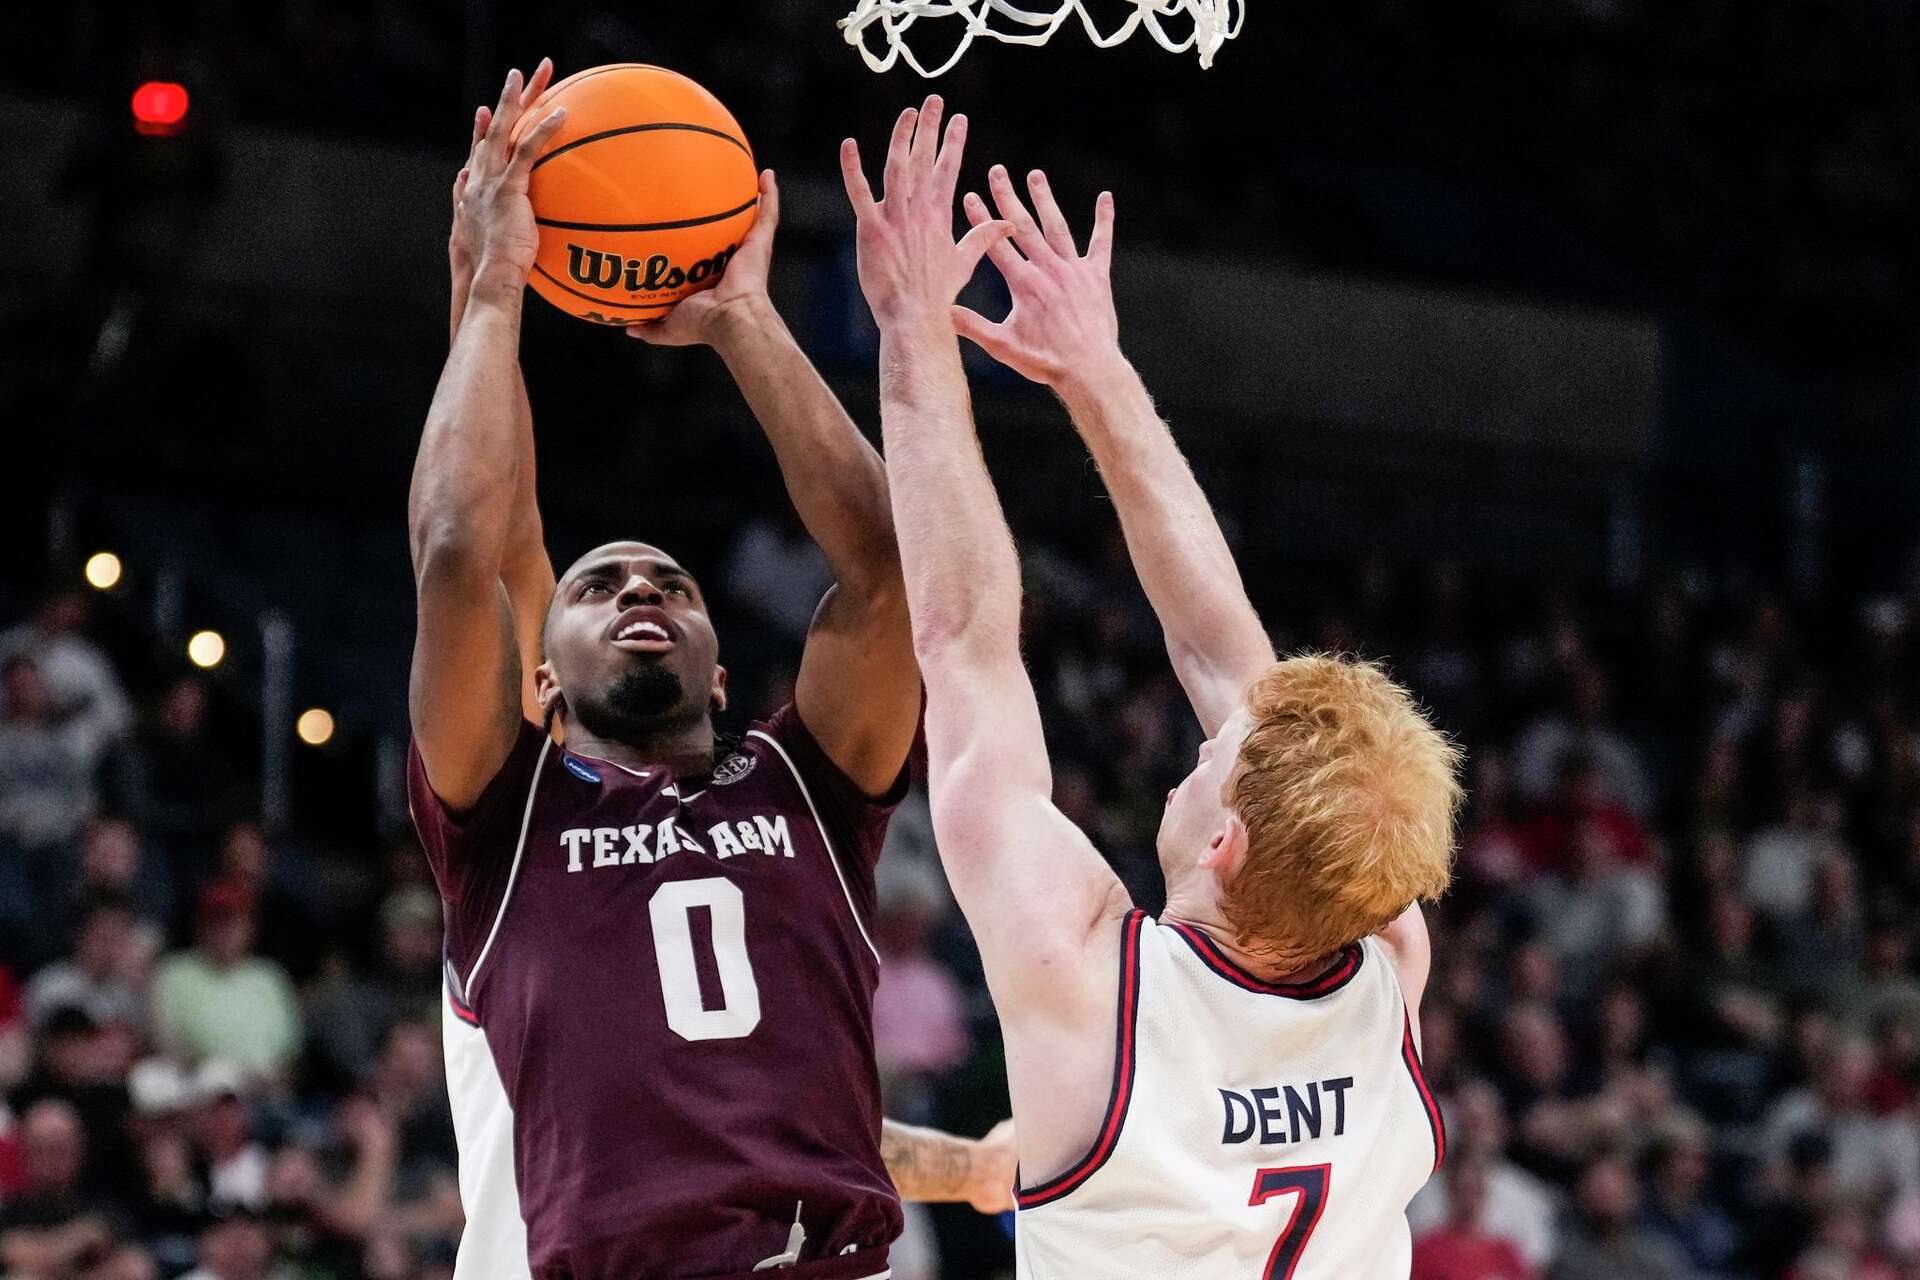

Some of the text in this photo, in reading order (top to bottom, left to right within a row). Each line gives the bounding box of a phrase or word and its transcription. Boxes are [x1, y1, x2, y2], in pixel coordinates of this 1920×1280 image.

[707, 815, 795, 860] A&M
[648, 876, 762, 1042] 0
[1217, 1076, 1354, 1145] DENT
[1247, 1162, 1332, 1280] 7
